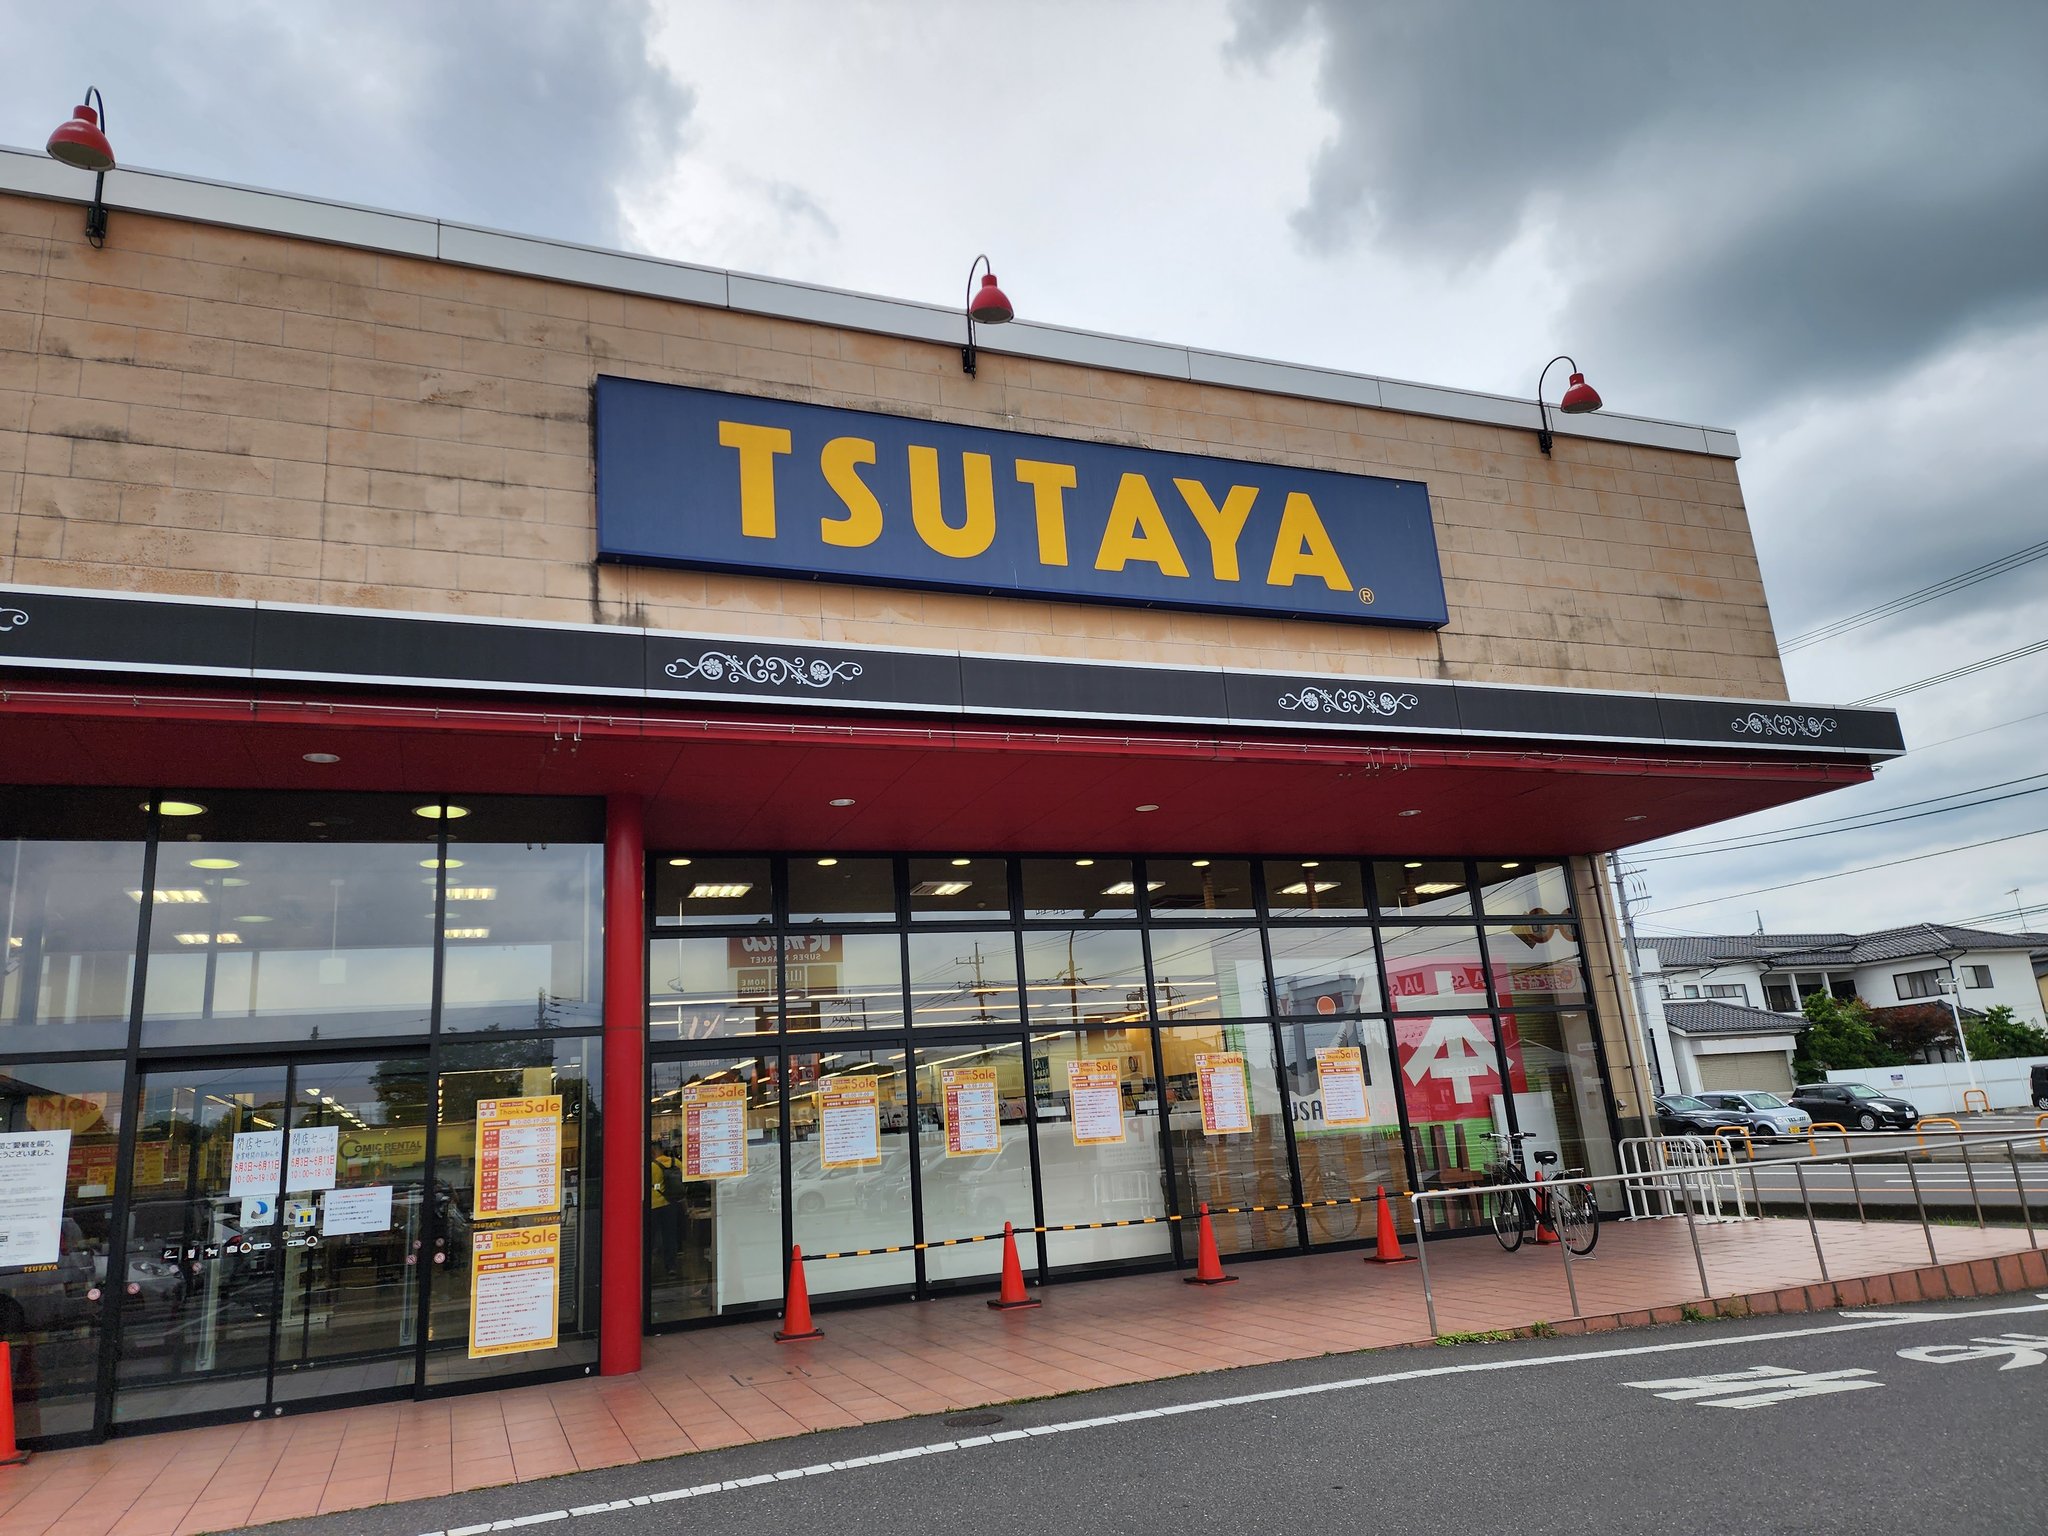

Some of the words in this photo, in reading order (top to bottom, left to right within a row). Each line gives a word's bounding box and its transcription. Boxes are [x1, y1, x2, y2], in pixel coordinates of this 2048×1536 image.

[718, 419, 1355, 593] TSUTAYA
[1341, 1050, 1360, 1060] Sale
[1096, 1061, 1118, 1072] Sale
[972, 1069, 996, 1080] Sale
[851, 1078, 877, 1089] Sale
[718, 1086, 745, 1098] Sale
[525, 1099, 560, 1114] Sale
[236, 1136, 280, 1151] 閉店セール
[340, 1139, 382, 1160] COMIC
[383, 1140, 423, 1152] RENTAL
[521, 1229, 558, 1245] Sale
[496, 1240, 520, 1248] Thanks
[23, 1264, 59, 1273] TSUTAYA
